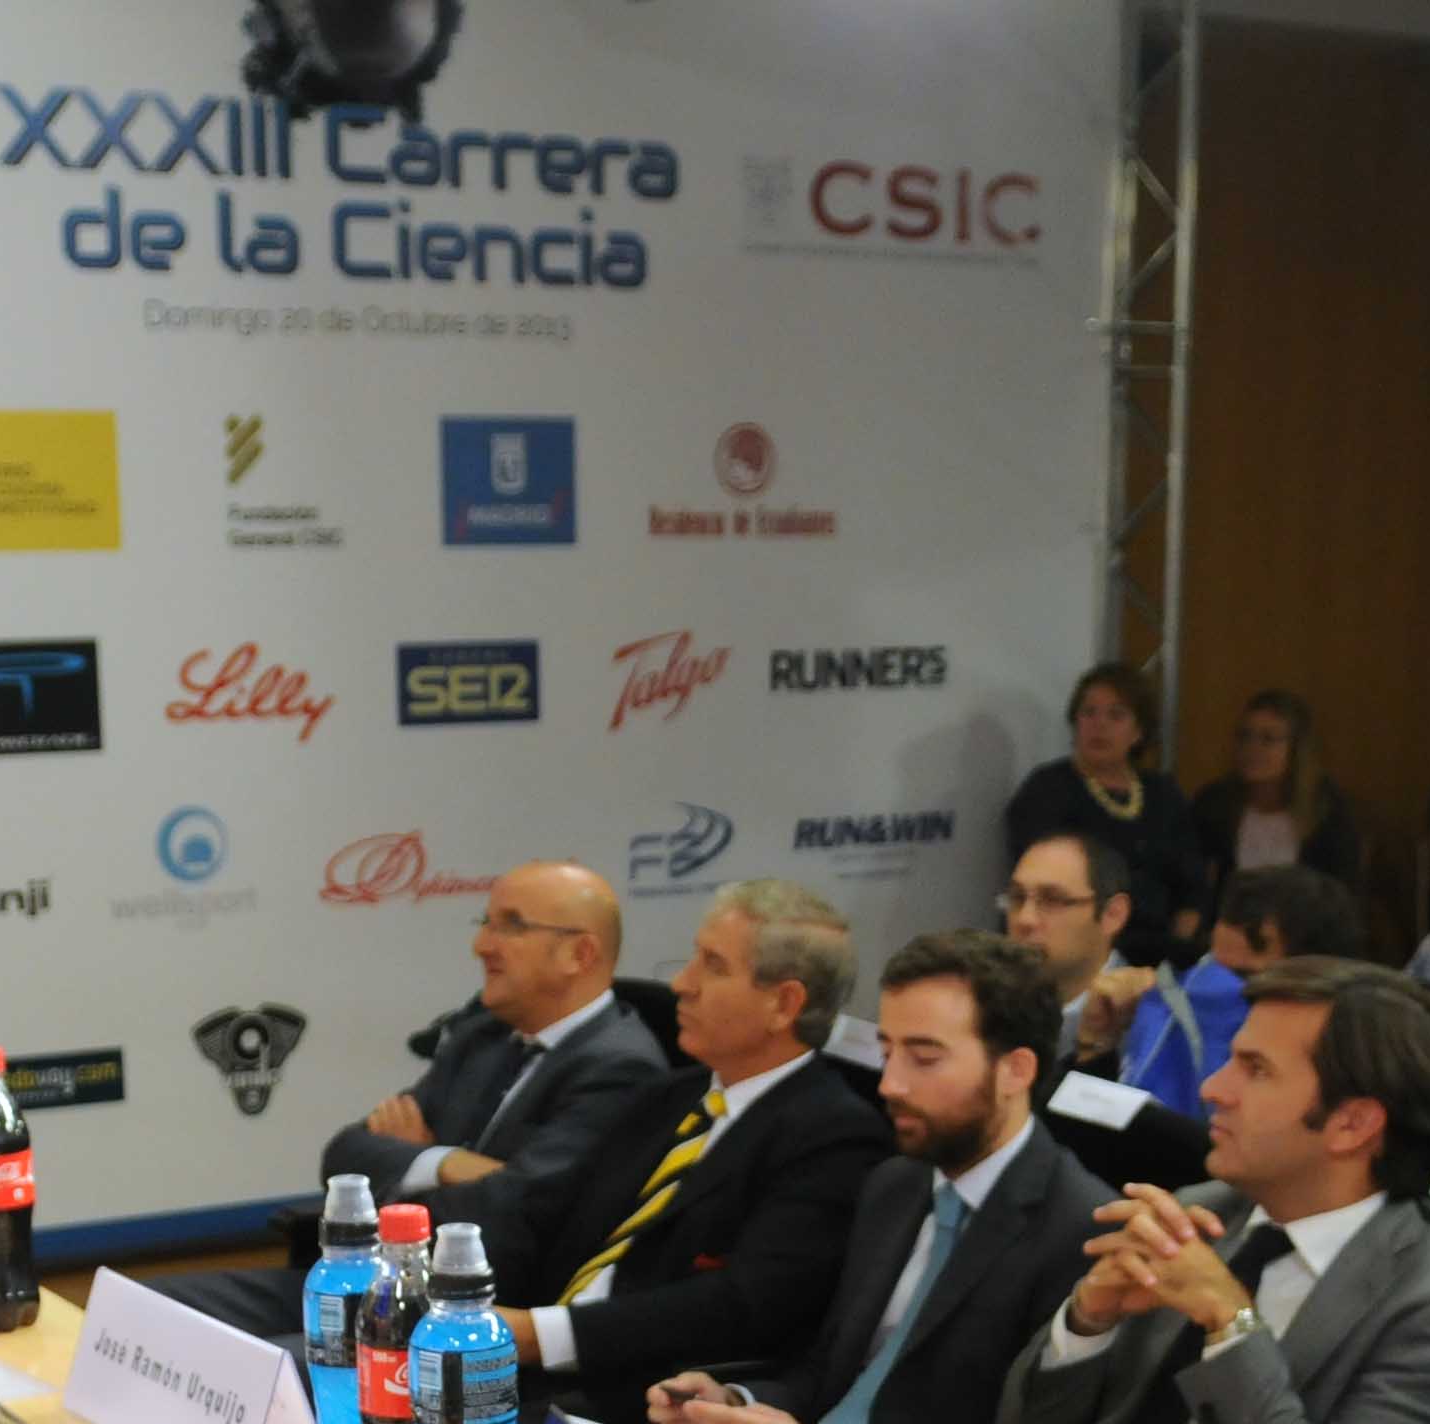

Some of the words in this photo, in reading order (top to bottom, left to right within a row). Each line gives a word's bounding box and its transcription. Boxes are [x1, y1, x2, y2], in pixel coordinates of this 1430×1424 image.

[325, 103, 680, 200] Carrera
[62, 184, 186, 271] de
[217, 191, 300, 275] la
[332, 200, 648, 290] Ciencia
[810, 159, 1041, 247] CSIC
[141, 297, 270, 336] Domingo
[317, 306, 354, 334] de
[359, 303, 468, 336] Octubre
[474, 309, 507, 335] de
[166, 643, 337, 744] Lilly
[407, 664, 529, 717] SER
[607, 630, 733, 733] Talgo
[93, 1328, 127, 1365] José
[131, 1345, 181, 1393] Ramón
